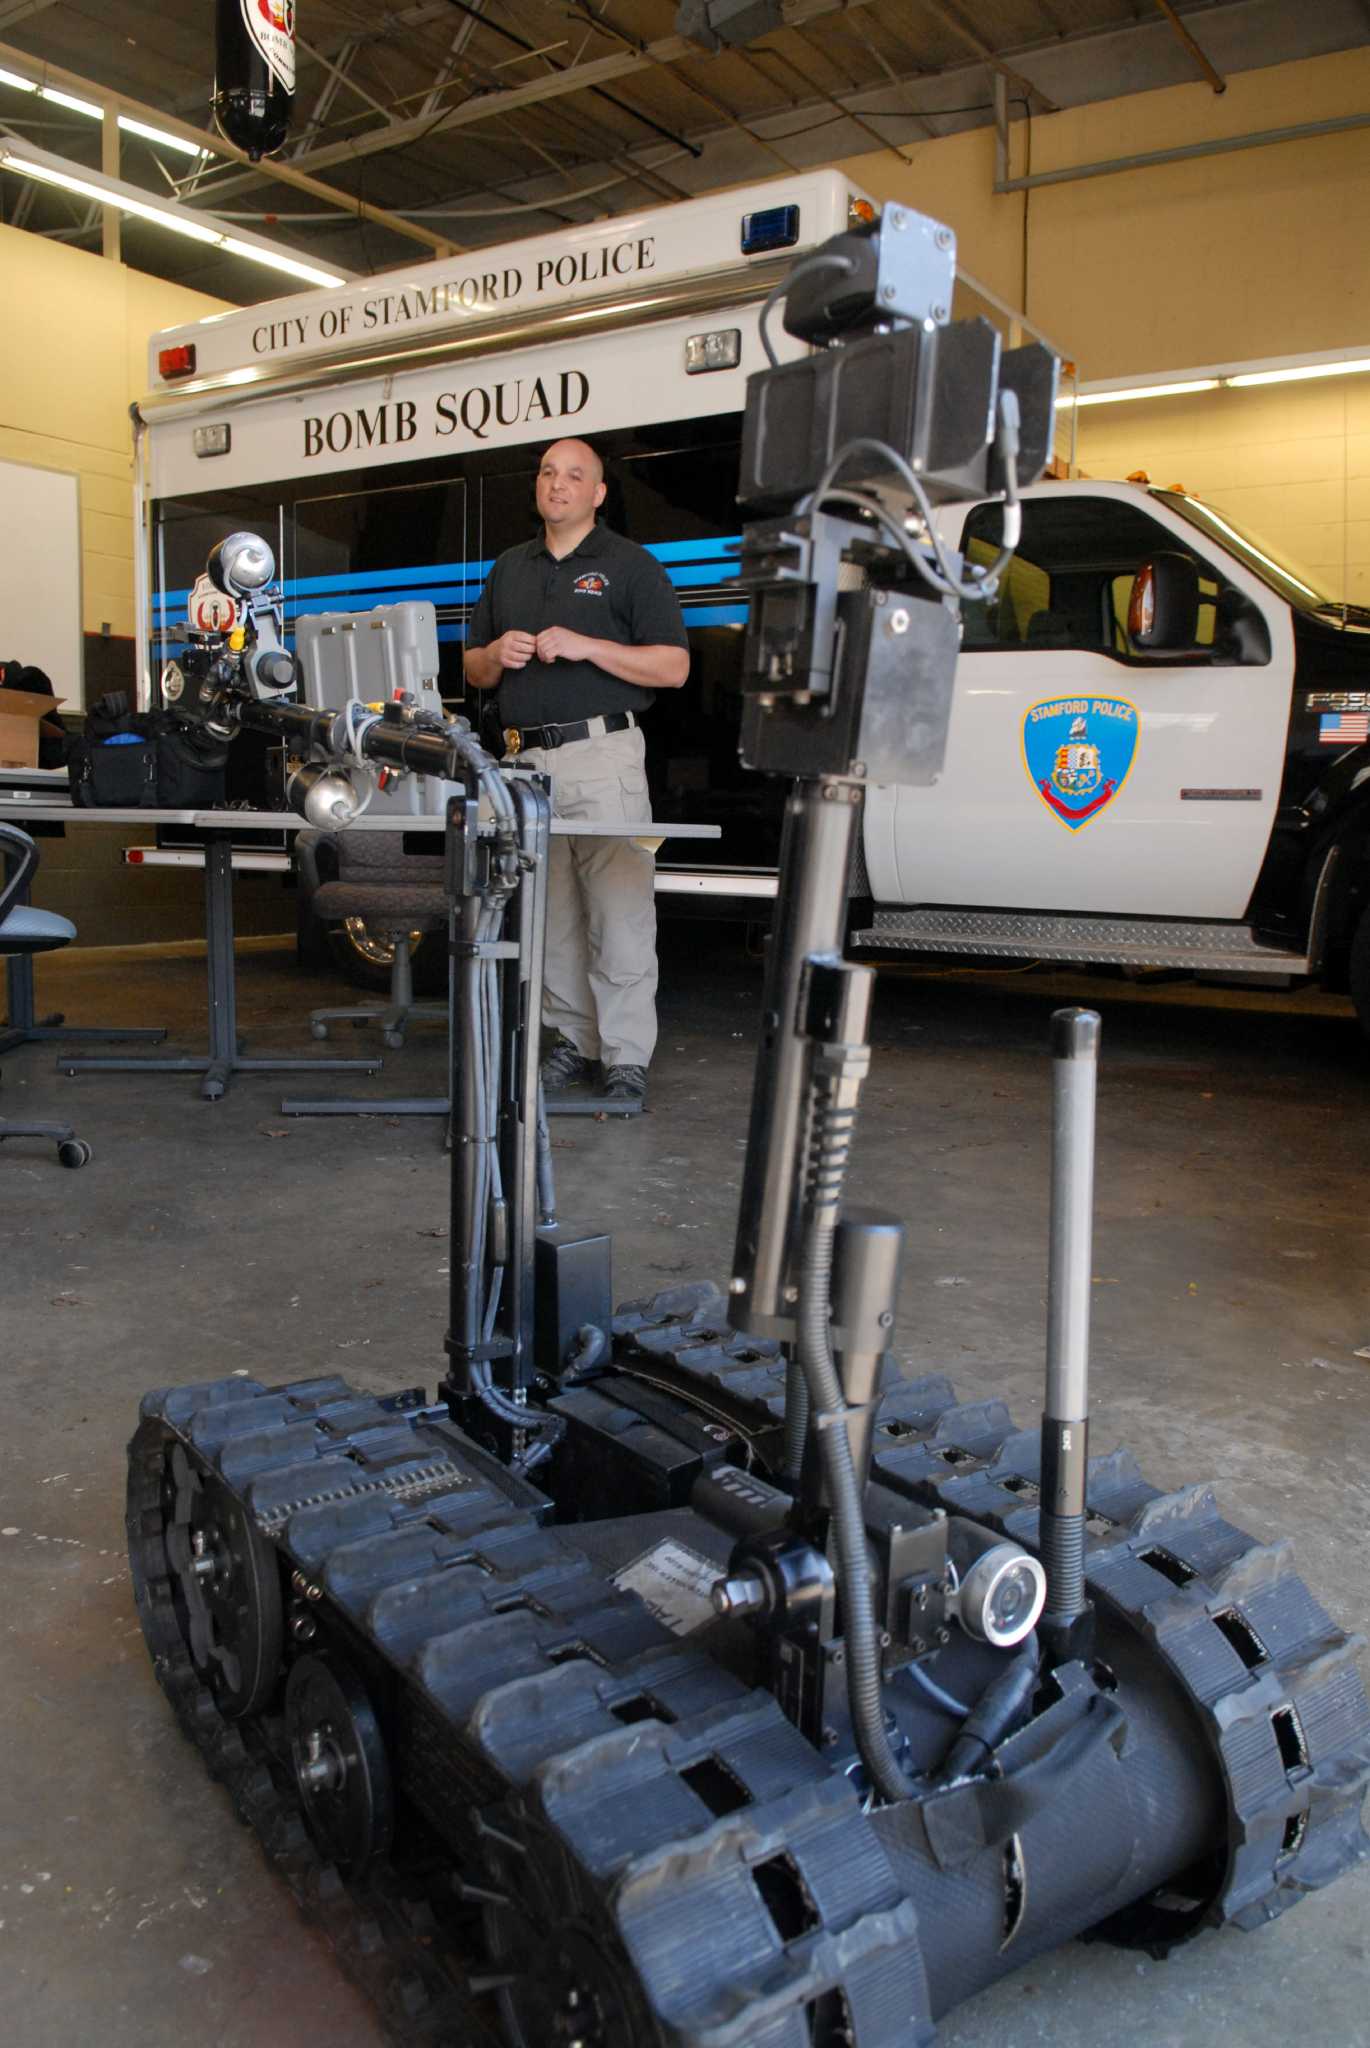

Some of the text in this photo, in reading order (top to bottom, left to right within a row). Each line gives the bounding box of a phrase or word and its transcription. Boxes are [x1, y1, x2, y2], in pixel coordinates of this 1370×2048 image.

[252, 236, 656, 354] CITY OF STAMFORD POLICE
[302, 369, 590, 458] BOMB SQUAD
[1029, 700, 1136, 722] STAMFORD POLICE
[1305, 692, 1370, 707] F55
